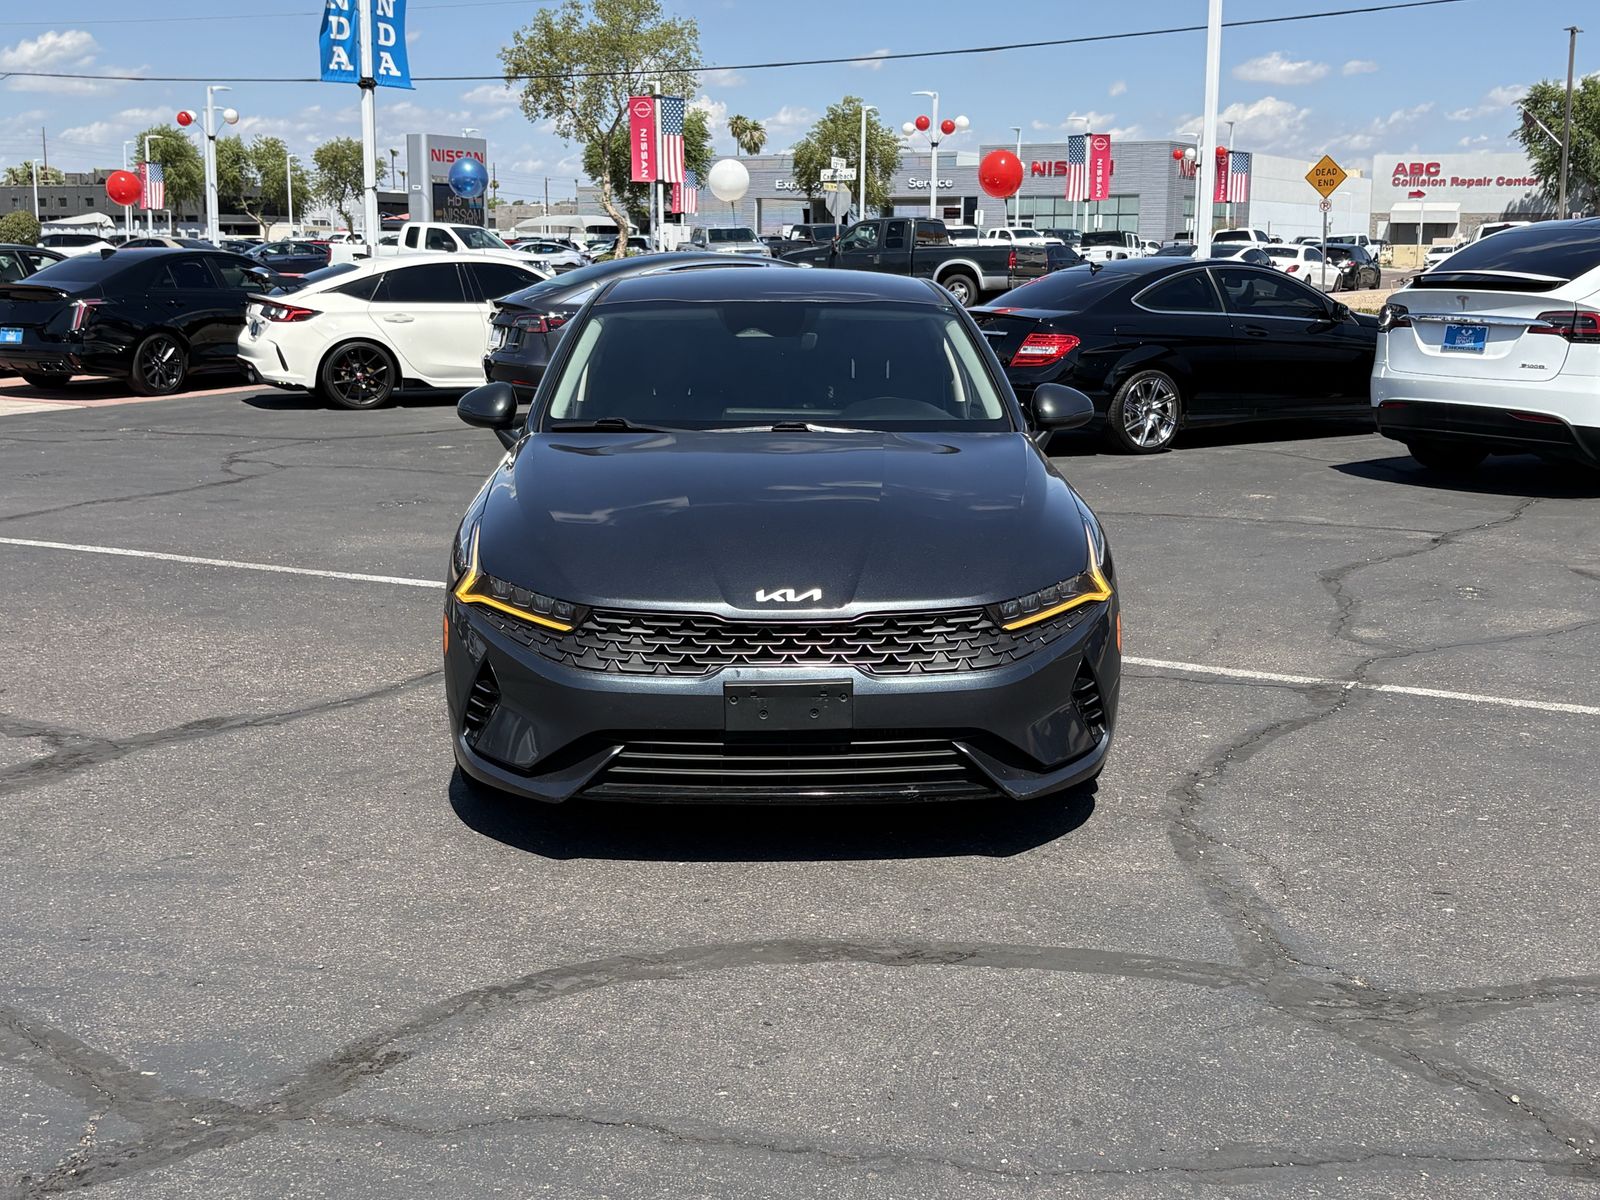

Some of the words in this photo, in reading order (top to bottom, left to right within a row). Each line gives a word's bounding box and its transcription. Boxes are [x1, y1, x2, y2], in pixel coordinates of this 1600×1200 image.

[640, 128, 648, 178] NISSAN
[1315, 168, 1337, 176] DEAD
[1392, 162, 1441, 177] ABC
[1318, 179, 1335, 187] END
[1392, 176, 1446, 187] Collision
[1450, 176, 1493, 188] Repair
[1496, 176, 1540, 187] Center
